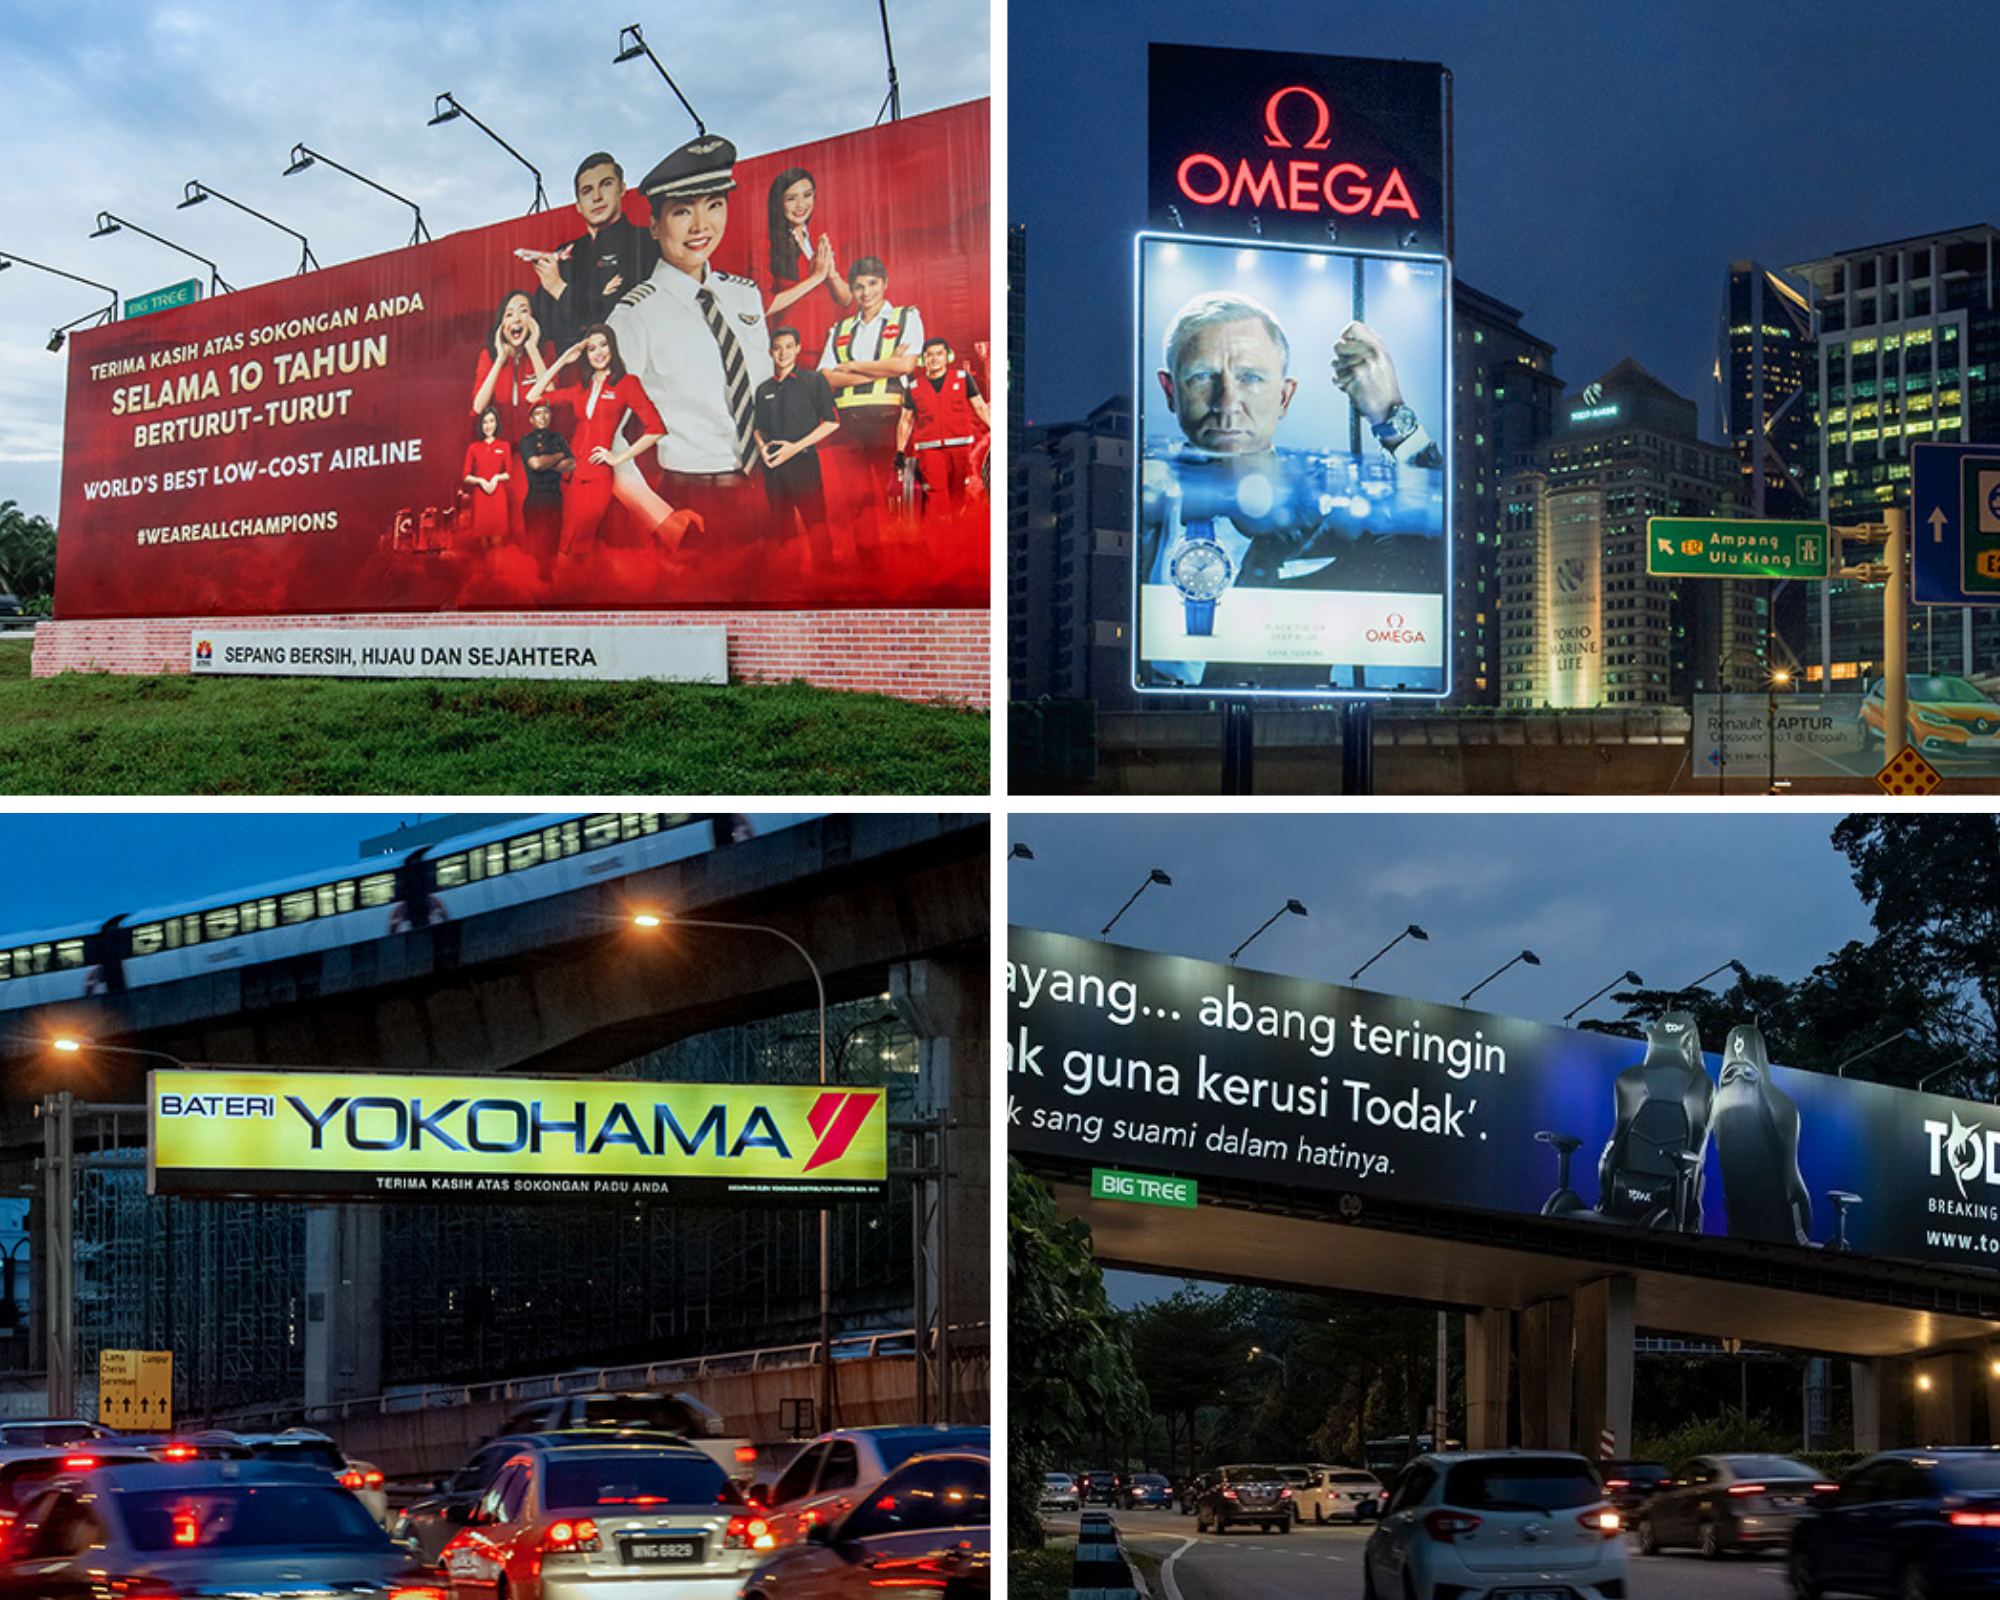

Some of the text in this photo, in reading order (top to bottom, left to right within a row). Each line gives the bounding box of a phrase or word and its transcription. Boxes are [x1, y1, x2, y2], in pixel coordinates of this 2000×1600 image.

[1177, 153, 1420, 220] OMEGA
[128, 287, 188, 316] BIG TREE
[90, 292, 424, 381] TERIMA KASIH ATAS SOKONGAN ANDA
[111, 335, 388, 416] SELAMA 10 TAHUN
[133, 389, 353, 449] BERTURUT-TURUT
[84, 439, 423, 500] WORLD'S BEST LOW-COST AIRLINE
[137, 511, 338, 546] #WEAREALLCHAMPIONS
[1709, 532, 1778, 550] Ampang
[1709, 551, 1738, 564] Ulu
[1365, 628, 1426, 644] OMEGA
[224, 646, 598, 668] SEPANG BERSIH, HIJAU DAN SEJAHTERA
[1557, 656, 1584, 672] LIFE
[1199, 984, 1335, 1057] abang
[1350, 1015, 1506, 1080] teringin
[159, 1095, 275, 1117] BATERI
[1062, 1050, 1180, 1096] guna
[1197, 1054, 1328, 1118] kerusi
[1342, 1079, 1488, 1141] Todak'.
[283, 1096, 793, 1159] YOKOHAMA
[1031, 1105, 1103, 1143] sang
[1112, 1119, 1197, 1148] suami
[1205, 1125, 1288, 1161] dalam
[1297, 1135, 1395, 1178] hatinya.
[376, 1177, 669, 1194] TERIMA KASIH ATAS SOKONGAN PADU ANDA
[1102, 1175, 1187, 1202] BIG TREE
[1928, 1198, 1998, 1221] BREAKING
[1926, 1231, 2000, 1253] www.to
